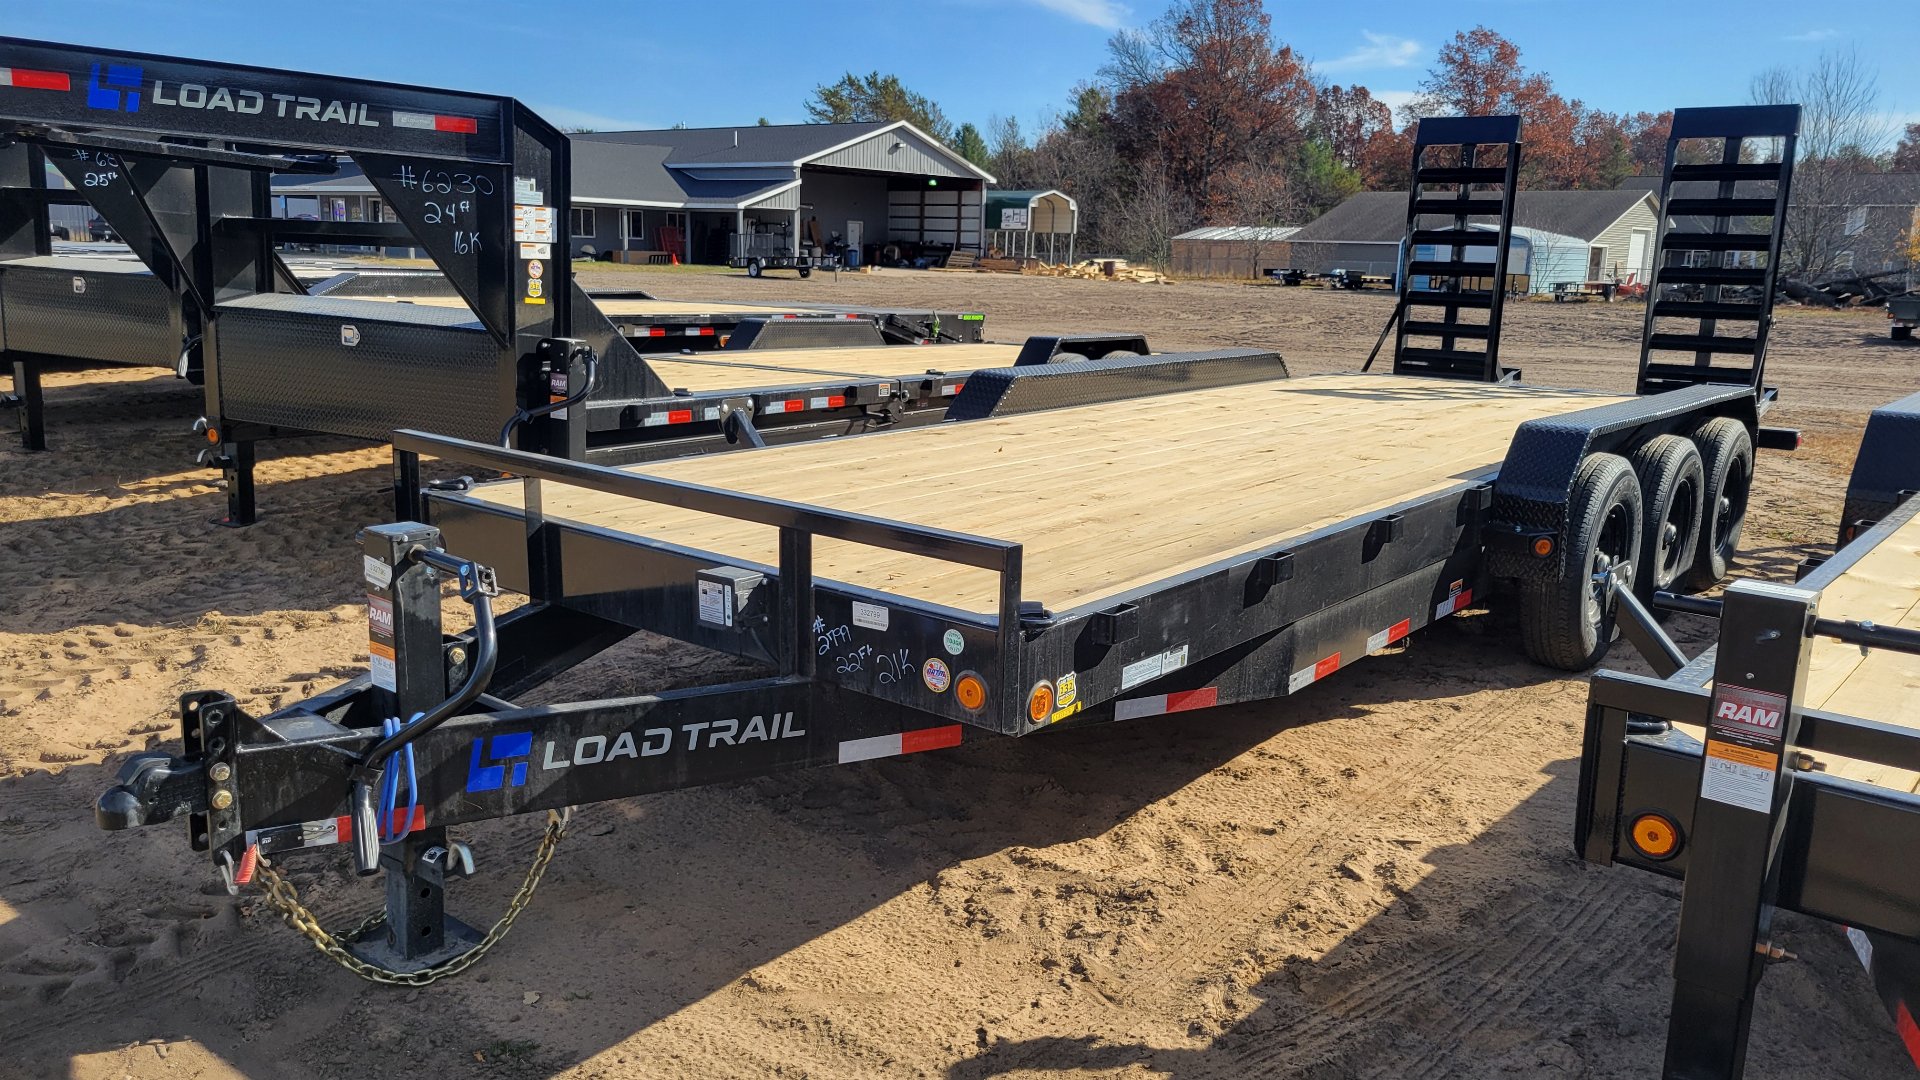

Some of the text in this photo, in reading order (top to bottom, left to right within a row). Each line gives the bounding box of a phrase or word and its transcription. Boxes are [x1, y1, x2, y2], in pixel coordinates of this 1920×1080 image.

[152, 80, 380, 127] LOAD TRAIL
[392, 165, 494, 195] #6230
[551, 379, 567, 388] RAM
[369, 606, 392, 626] RAM
[1717, 701, 1780, 728] RAM
[542, 711, 806, 770] LOAD TRAIL
